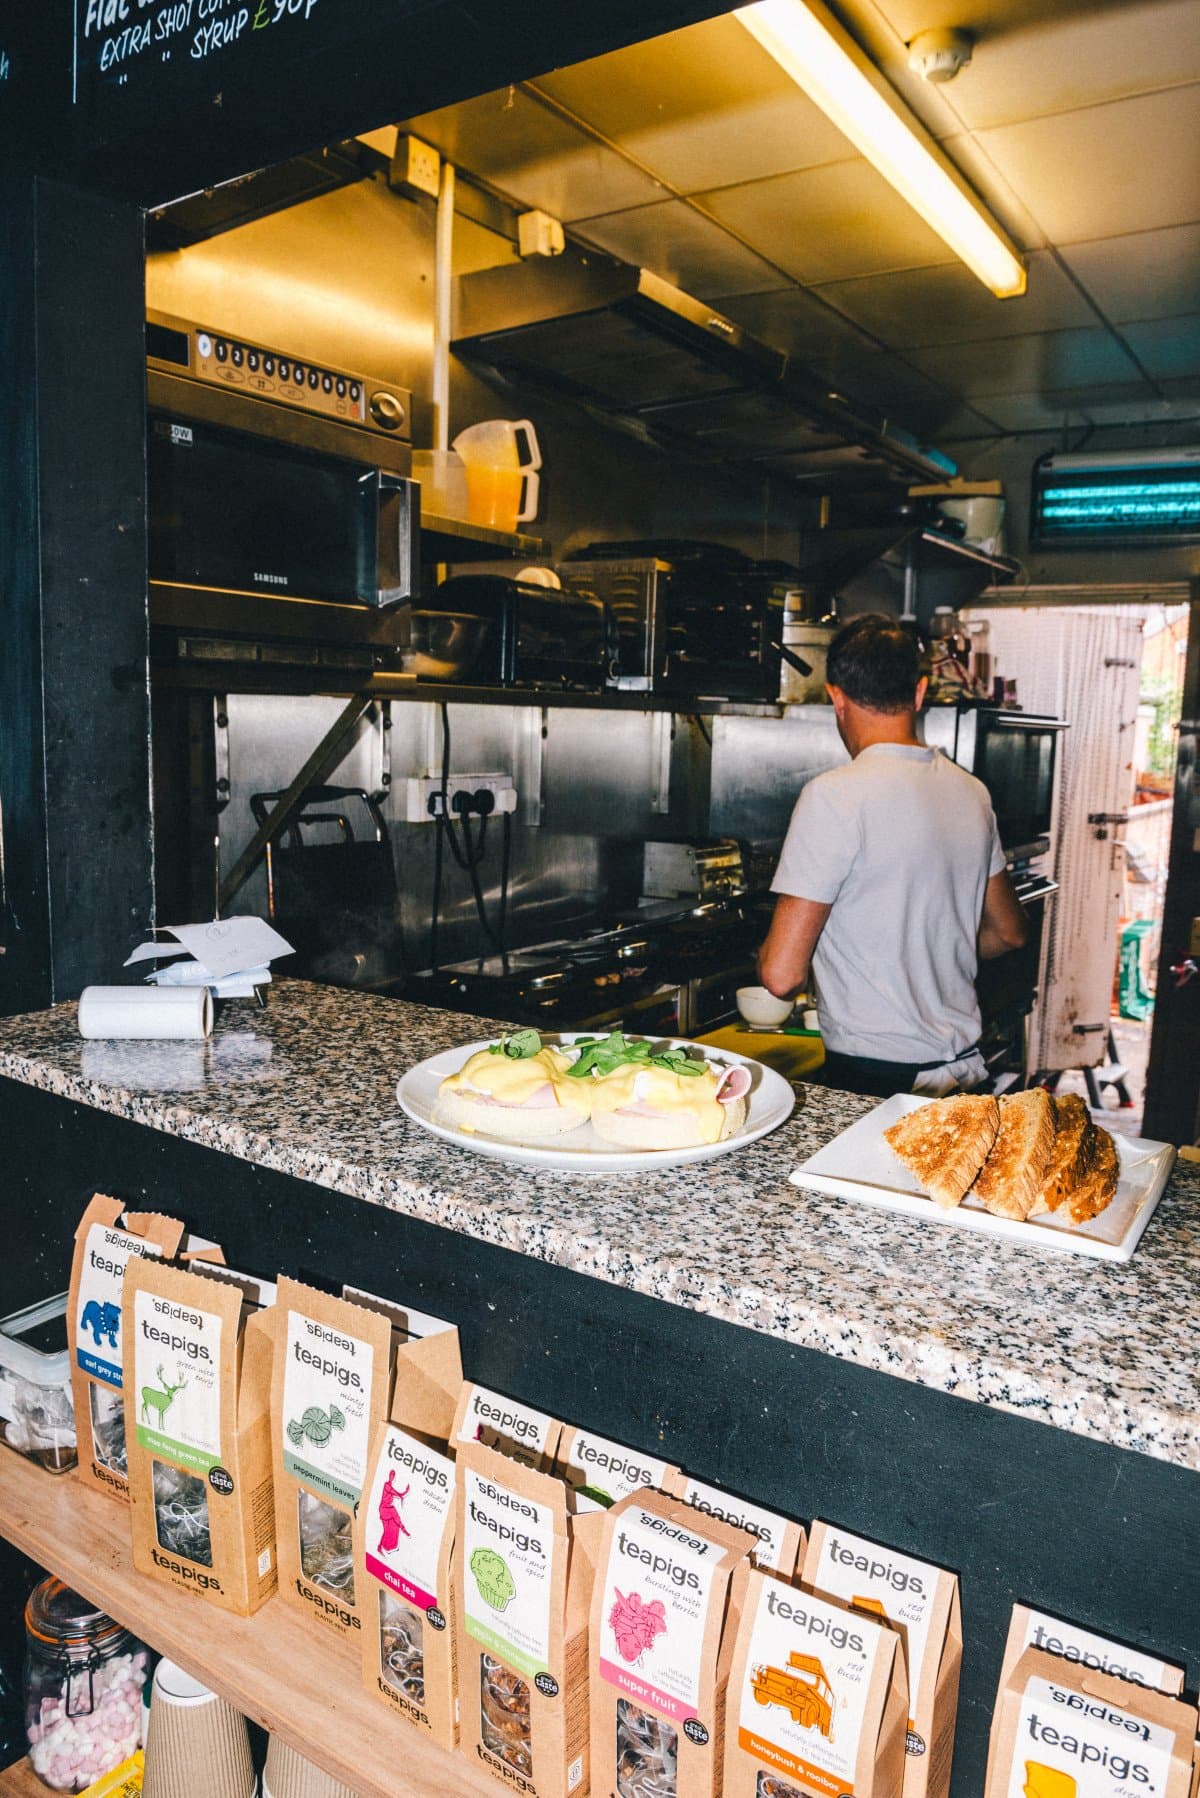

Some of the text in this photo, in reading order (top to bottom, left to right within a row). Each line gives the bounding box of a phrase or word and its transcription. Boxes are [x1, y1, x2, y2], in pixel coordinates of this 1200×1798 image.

[100, 1, 193, 72] EXTRA SHOT
[190, 8, 248, 58] SYRUP
[254, 572, 288, 585] SAMSUNG
[90, 1250, 128, 1278] teapi
[152, 1298, 204, 1331] teapigs.
[304, 1319, 356, 1357] teapigs.
[141, 1320, 213, 1365] teapigs.
[97, 1365, 111, 1378] grey
[294, 1340, 364, 1394] teapigs.
[473, 1396, 540, 1443] teapigs.
[90, 1462, 130, 1497] teapi
[209, 1474, 233, 1489] taste
[293, 1463, 331, 1490] peppermint
[332, 1482, 355, 1501] leaves
[388, 1437, 449, 1494] teapigs.
[475, 1476, 541, 1524] teapigs.
[468, 1500, 547, 1559] teapigs.
[640, 1512, 710, 1557] teapigs.
[151, 1549, 224, 1596] teapigs.
[384, 1571, 400, 1589] chai
[402, 1583, 416, 1599] tea
[618, 1532, 703, 1597] teapigs.
[829, 1538, 927, 1601] teapigs.
[767, 1591, 867, 1660] teapigs.
[377, 1676, 432, 1729] teapigs.
[536, 1678, 558, 1693] taste
[618, 1674, 649, 1698] super
[650, 1690, 676, 1714] fruit
[685, 1723, 708, 1741] taste
[1049, 1685, 1153, 1742] teapigs.
[751, 1740, 840, 1792] honeybush & rooibos
[1027, 1714, 1155, 1792] teapigs.
